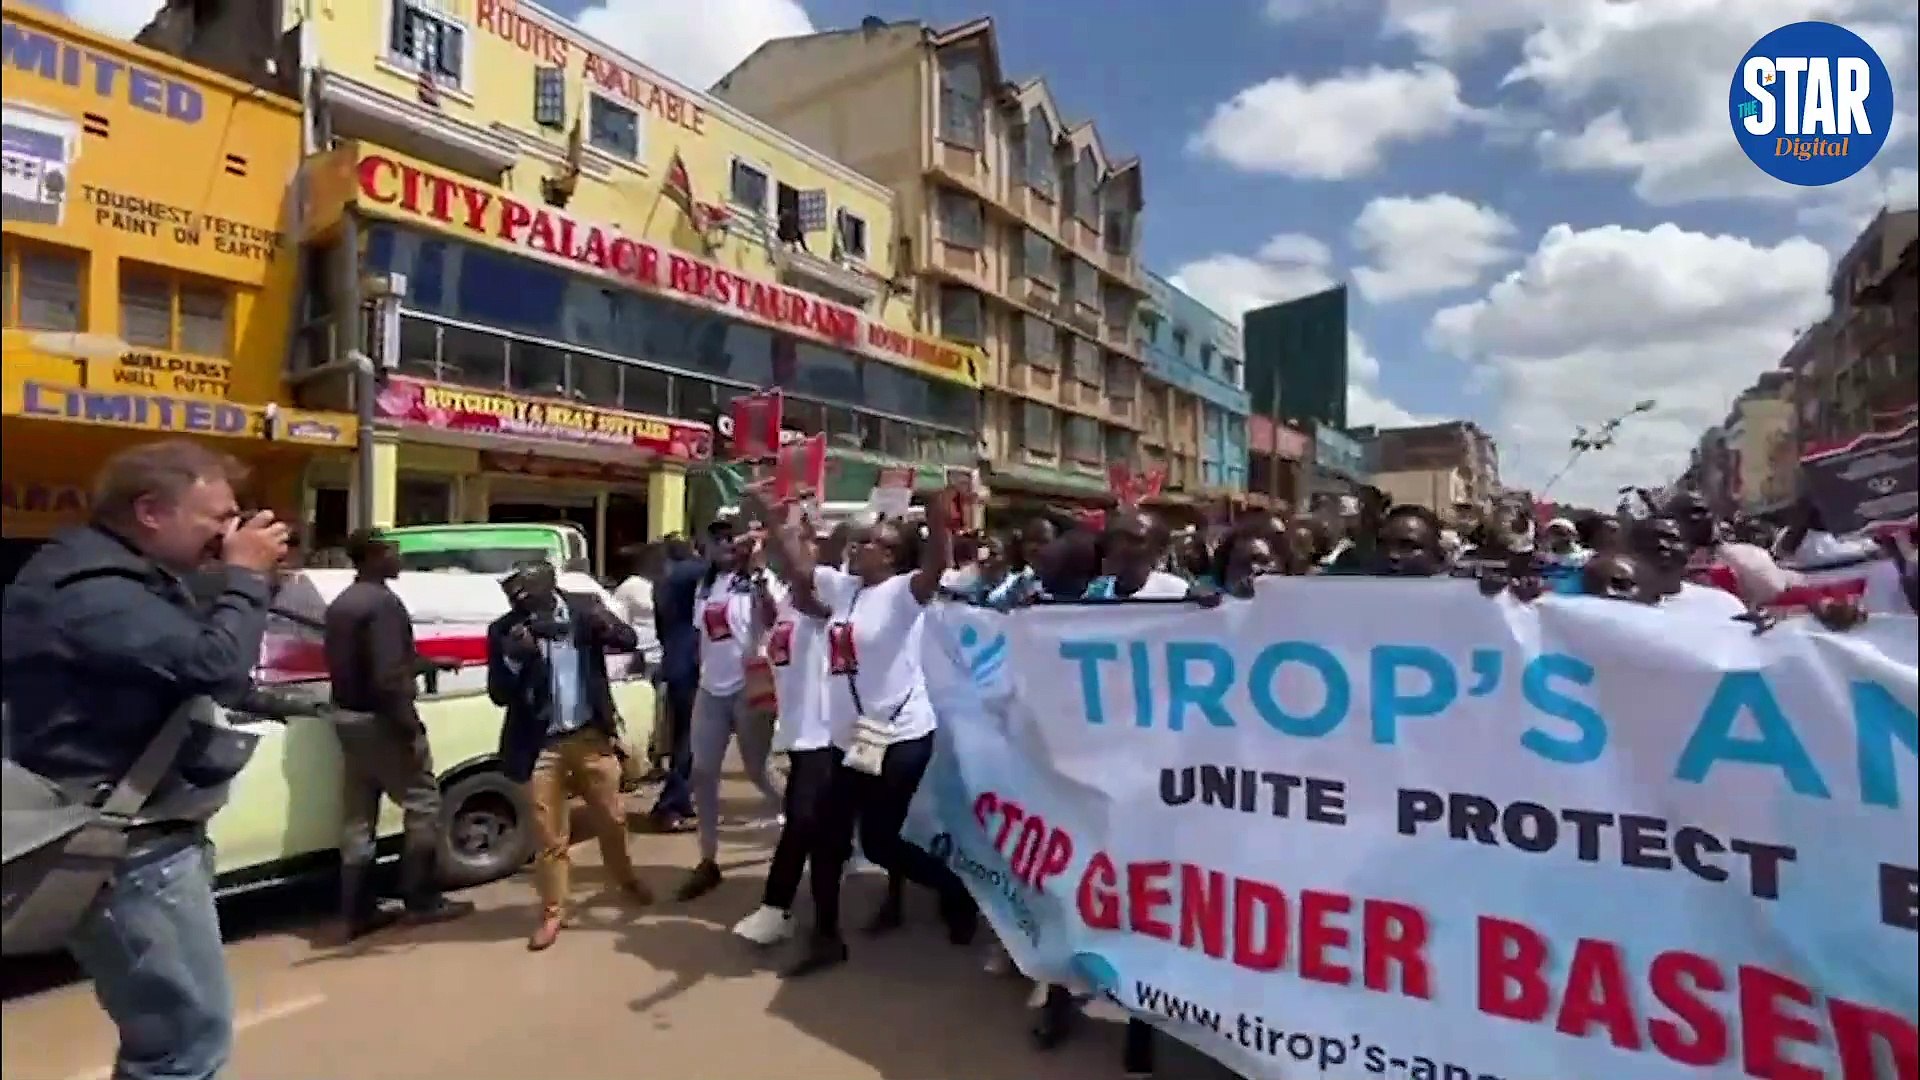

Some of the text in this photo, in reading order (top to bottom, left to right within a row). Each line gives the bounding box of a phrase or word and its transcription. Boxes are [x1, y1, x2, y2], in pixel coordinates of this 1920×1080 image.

[583, 52, 706, 136] AVAILABLE
[82, 184, 286, 250] TOUGHEST TEXTURE
[96, 208, 276, 262] PAINT ON EARTH
[357, 155, 494, 233] CITY
[497, 199, 658, 285] PALACE
[23, 380, 248, 433] LIMITED
[173, 375, 232, 397] PUTTY
[1059, 639, 1609, 765] TIROP'S
[1160, 764, 1348, 826] UNITE
[1397, 787, 1798, 900] PROTECT
[973, 791, 1073, 895] STOP
[1076, 850, 1431, 1001] GENDER
[1476, 914, 1918, 1080] BASED
[1134, 979, 1506, 1080] www.tirop's-an
